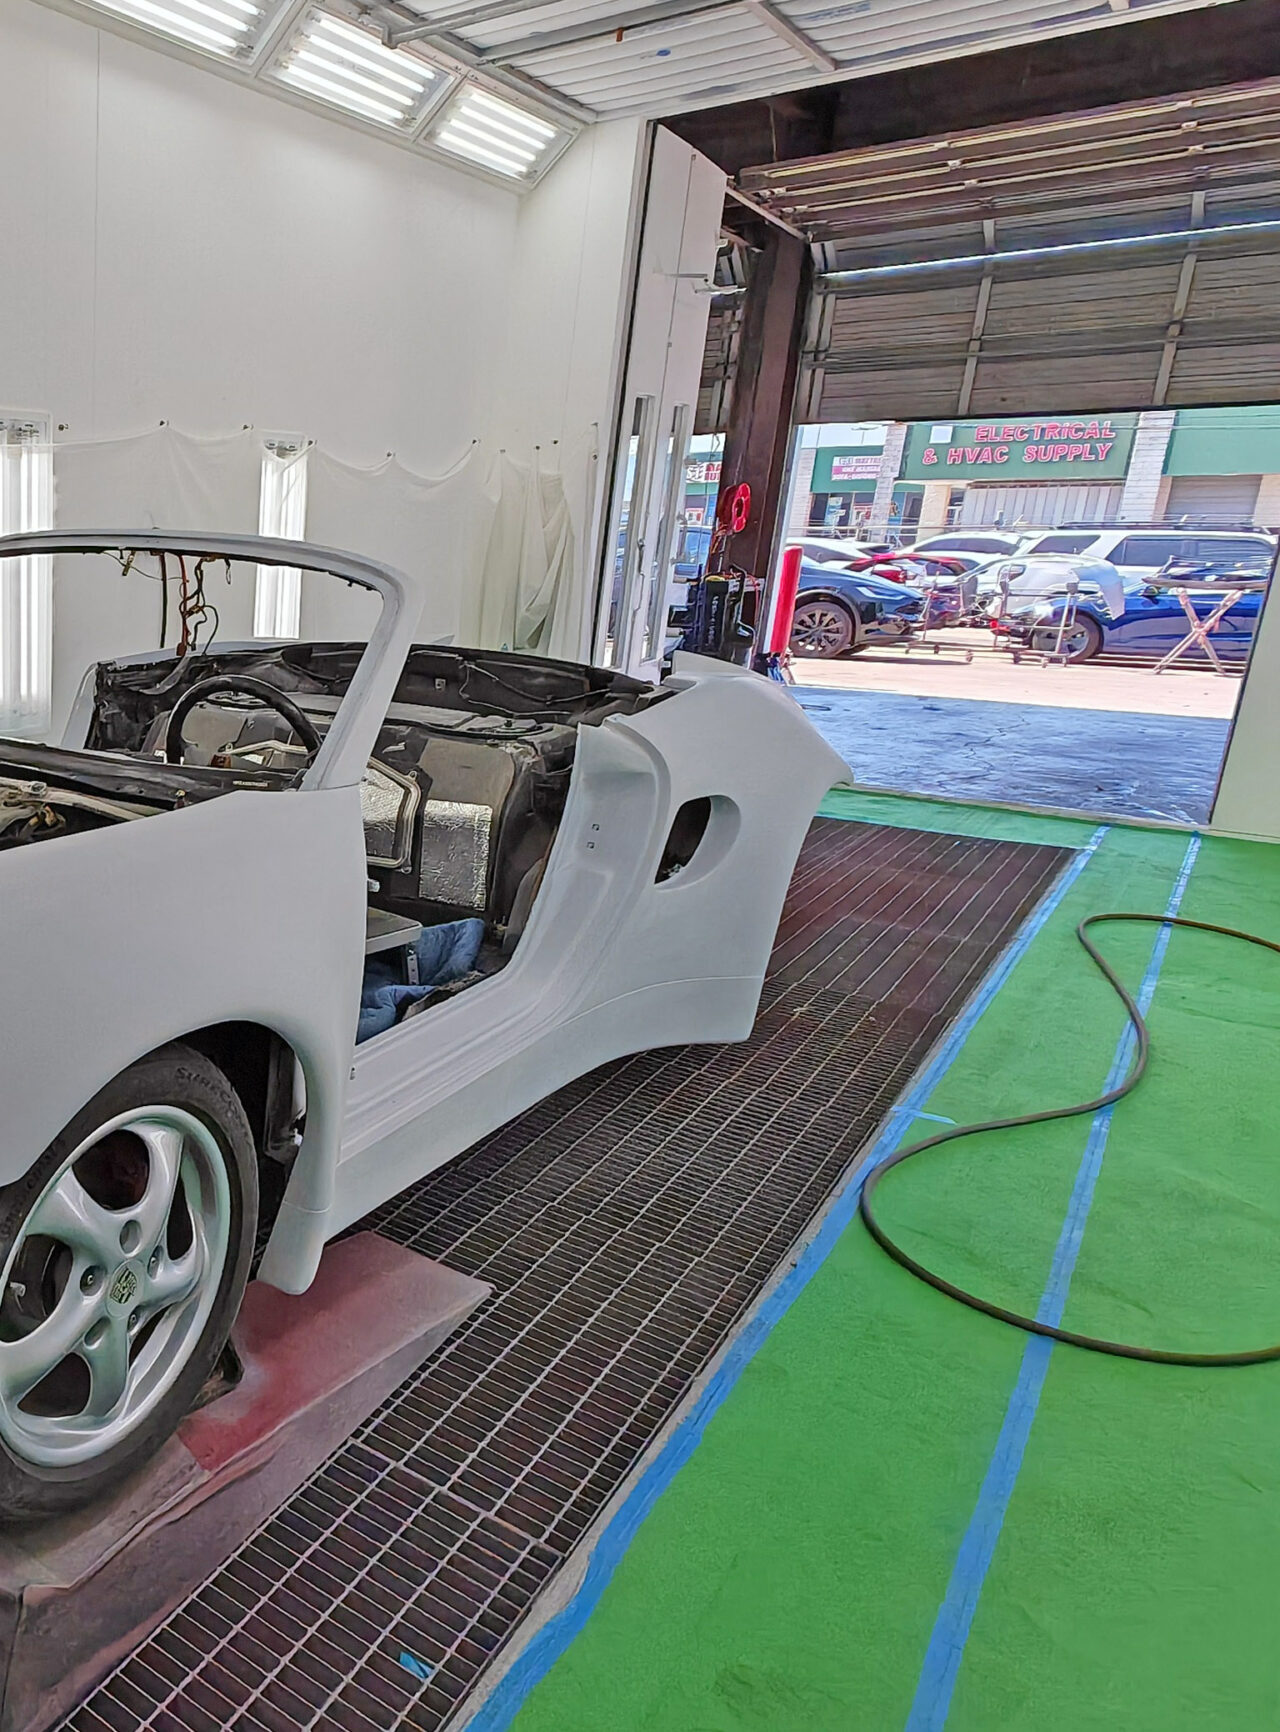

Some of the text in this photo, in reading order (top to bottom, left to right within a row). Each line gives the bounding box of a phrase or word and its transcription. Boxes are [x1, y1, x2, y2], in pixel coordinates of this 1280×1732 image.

[974, 420, 1117, 442] ELECTRICAL
[922, 442, 1113, 465] & HVAC SUPPLY
